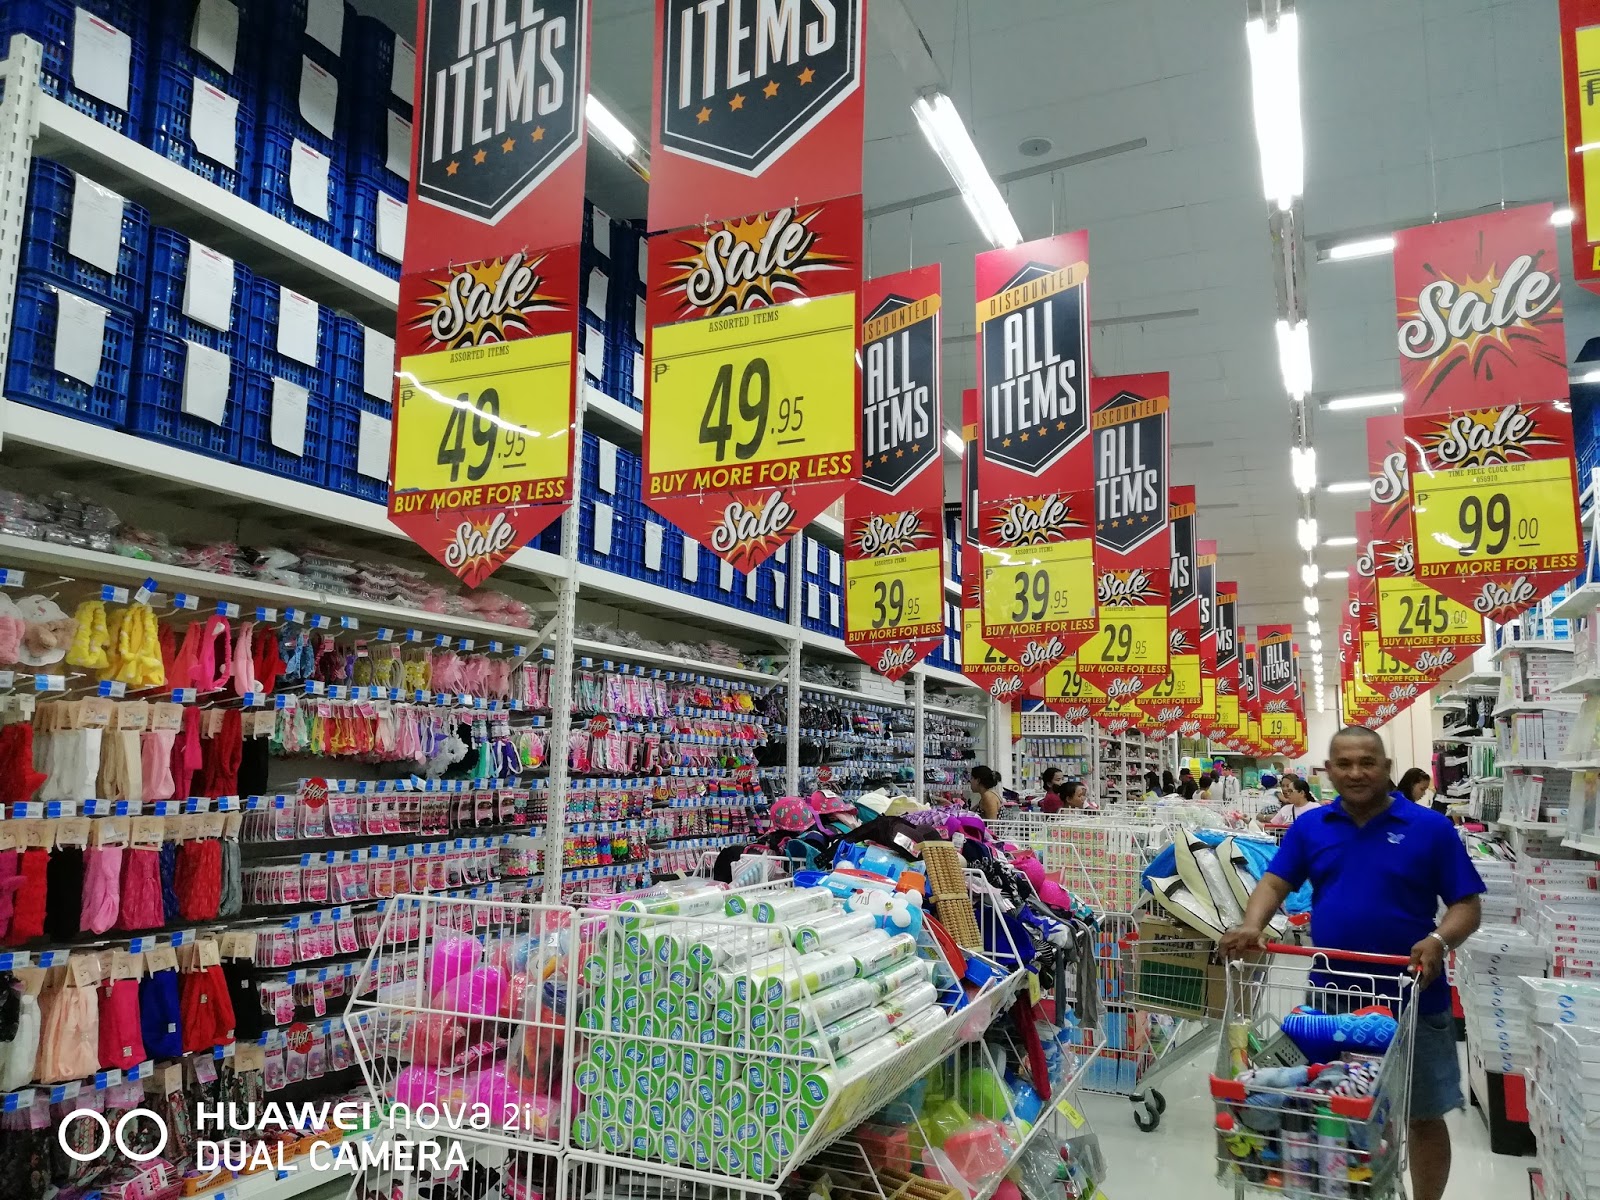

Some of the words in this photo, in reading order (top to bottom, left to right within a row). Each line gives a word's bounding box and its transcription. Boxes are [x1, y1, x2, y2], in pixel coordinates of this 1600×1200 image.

[679, 0, 837, 109] ITEMS
[433, 16, 566, 163] ITEMS
[687, 207, 816, 307] Sale
[431, 252, 543, 342] Sale
[990, 267, 1073, 315] DISCOUNTED
[864, 299, 928, 342] ISCOUNTED
[1398, 255, 1560, 358] Sale
[709, 315, 750, 332] ASSORTED
[752, 311, 780, 328] ITEMS
[450, 347, 486, 363] ASSORTED
[488, 345, 510, 360] ITEMS
[1004, 301, 1060, 379] ALL
[868, 331, 915, 405] ALL
[992, 360, 1076, 439] ITEMS
[1096, 399, 1157, 428] ISCOUNTED
[864, 386, 928, 456] TEMS
[1438, 403, 1534, 463] Sale
[1100, 423, 1146, 480] ALL
[650, 474, 684, 495] BUY
[692, 466, 754, 491] MORE
[759, 461, 799, 485] FOR
[807, 454, 853, 477] LESS
[1448, 470, 1465, 478] TIME
[1467, 467, 1485, 476] PIECE
[1488, 466, 1508, 474] CLOCK
[1511, 464, 1526, 472] GIFT
[394, 495, 427, 513] BUY
[431, 489, 483, 510] MORE
[486, 484, 521, 506] FOR
[527, 479, 565, 501] LESS
[1096, 470, 1158, 520] TEMS
[711, 491, 795, 552] Sale
[861, 511, 918, 553] Sale
[1000, 494, 1069, 542] Sale
[445, 513, 517, 568] Sale
[1015, 547, 1038, 556] ASSORTED
[1421, 564, 1450, 577] BUY
[1454, 561, 1501, 575] MORE
[1507, 558, 1538, 571] FOR
[1544, 555, 1577, 568] LESS
[1098, 568, 1149, 601] Sale
[1474, 576, 1537, 613] Sale
[849, 632, 866, 642] BUY
[869, 627, 896, 640] MORE
[899, 625, 918, 636] FOR
[922, 622, 941, 634] LESS
[986, 625, 1006, 636] BUY
[1010, 622, 1042, 635] MORE
[1046, 621, 1067, 633] FOR
[1072, 618, 1095, 631] LESS
[1383, 637, 1401, 646] BUY
[1405, 636, 1433, 645] MORE
[1437, 635, 1456, 644] FOR
[1461, 634, 1482, 643] LESS
[878, 644, 917, 671] Sale
[1021, 637, 1066, 666] Sale
[1267, 643, 1284, 665] ALL
[1415, 647, 1455, 671] Sale
[965, 665, 978, 673] BUY
[980, 664, 1006, 673] MORE
[1079, 665, 1098, 673] BUY
[1099, 665, 1124, 673] MORE
[1128, 665, 1144, 673] FOR
[1147, 665, 1166, 673] LESS
[1263, 661, 1290, 682] ITEMS
[990, 675, 1022, 696] Sale
[1108, 676, 1143, 697] Sale
[1389, 683, 1418, 700] Sale
[1065, 705, 1089, 720] Sale
[1158, 706, 1183, 721] Sale
[1375, 703, 1397, 717] Sale
[1109, 718, 1128, 731] Sale
[1180, 720, 1201, 732] Sale
[303, 782, 329, 800] Hot
[288, 1029, 311, 1049] Hot
